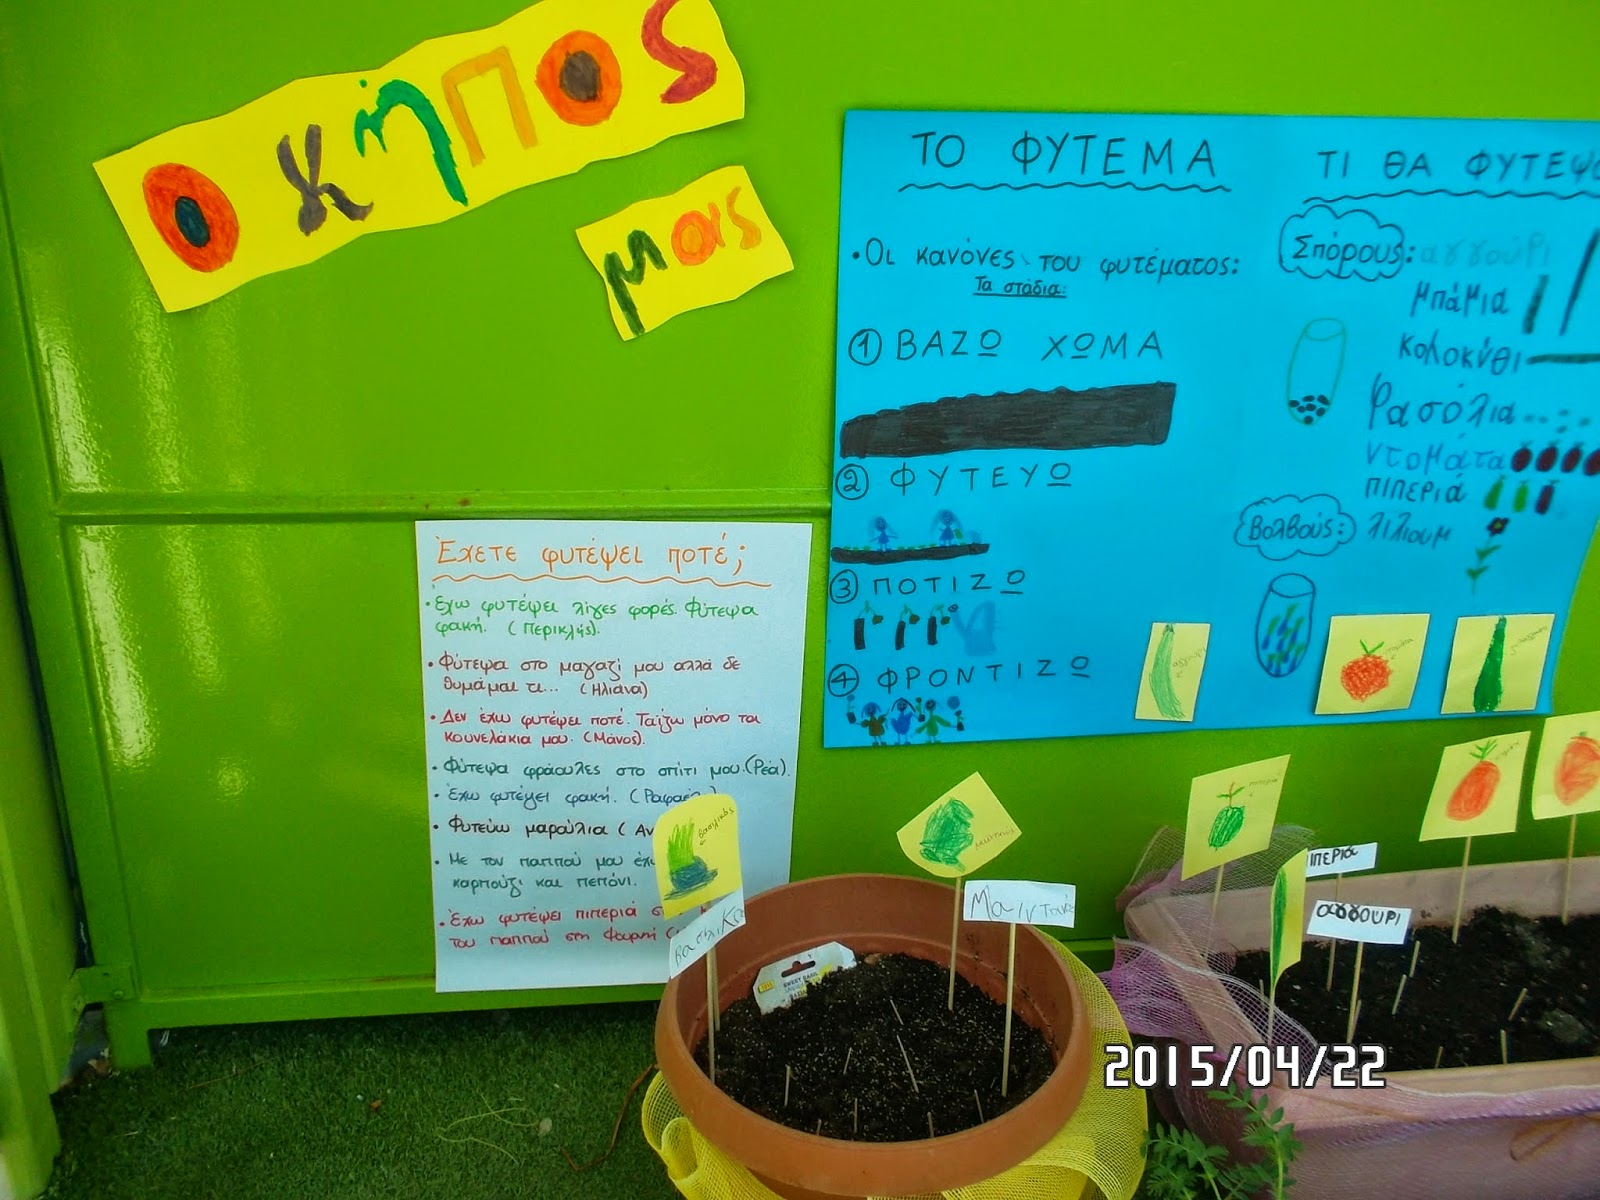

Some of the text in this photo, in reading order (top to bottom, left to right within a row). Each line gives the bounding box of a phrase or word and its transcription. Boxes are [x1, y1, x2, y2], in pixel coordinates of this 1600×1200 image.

[911, 130, 1216, 178] ΤΟ ΦΥΤΕΜΑ
[1317, 150, 1349, 179] ΤΙ
[1384, 150, 1432, 180] ΘΑ
[865, 237, 896, 267] Οι
[1038, 253, 1081, 273] του
[541, 537, 644, 573] φυτέψει
[481, 593, 559, 619] φυτέψει
[520, 659, 549, 672] στο
[633, 660, 665, 679] μου
[722, 655, 742, 671] δε
[439, 708, 468, 725] Δεν
[520, 710, 583, 729] φυτέψει
[616, 765, 646, 777] στο
[449, 851, 469, 866] Με
[595, 855, 624, 871] μου
[535, 878, 564, 888] και
[498, 906, 562, 928] φυτέψει
